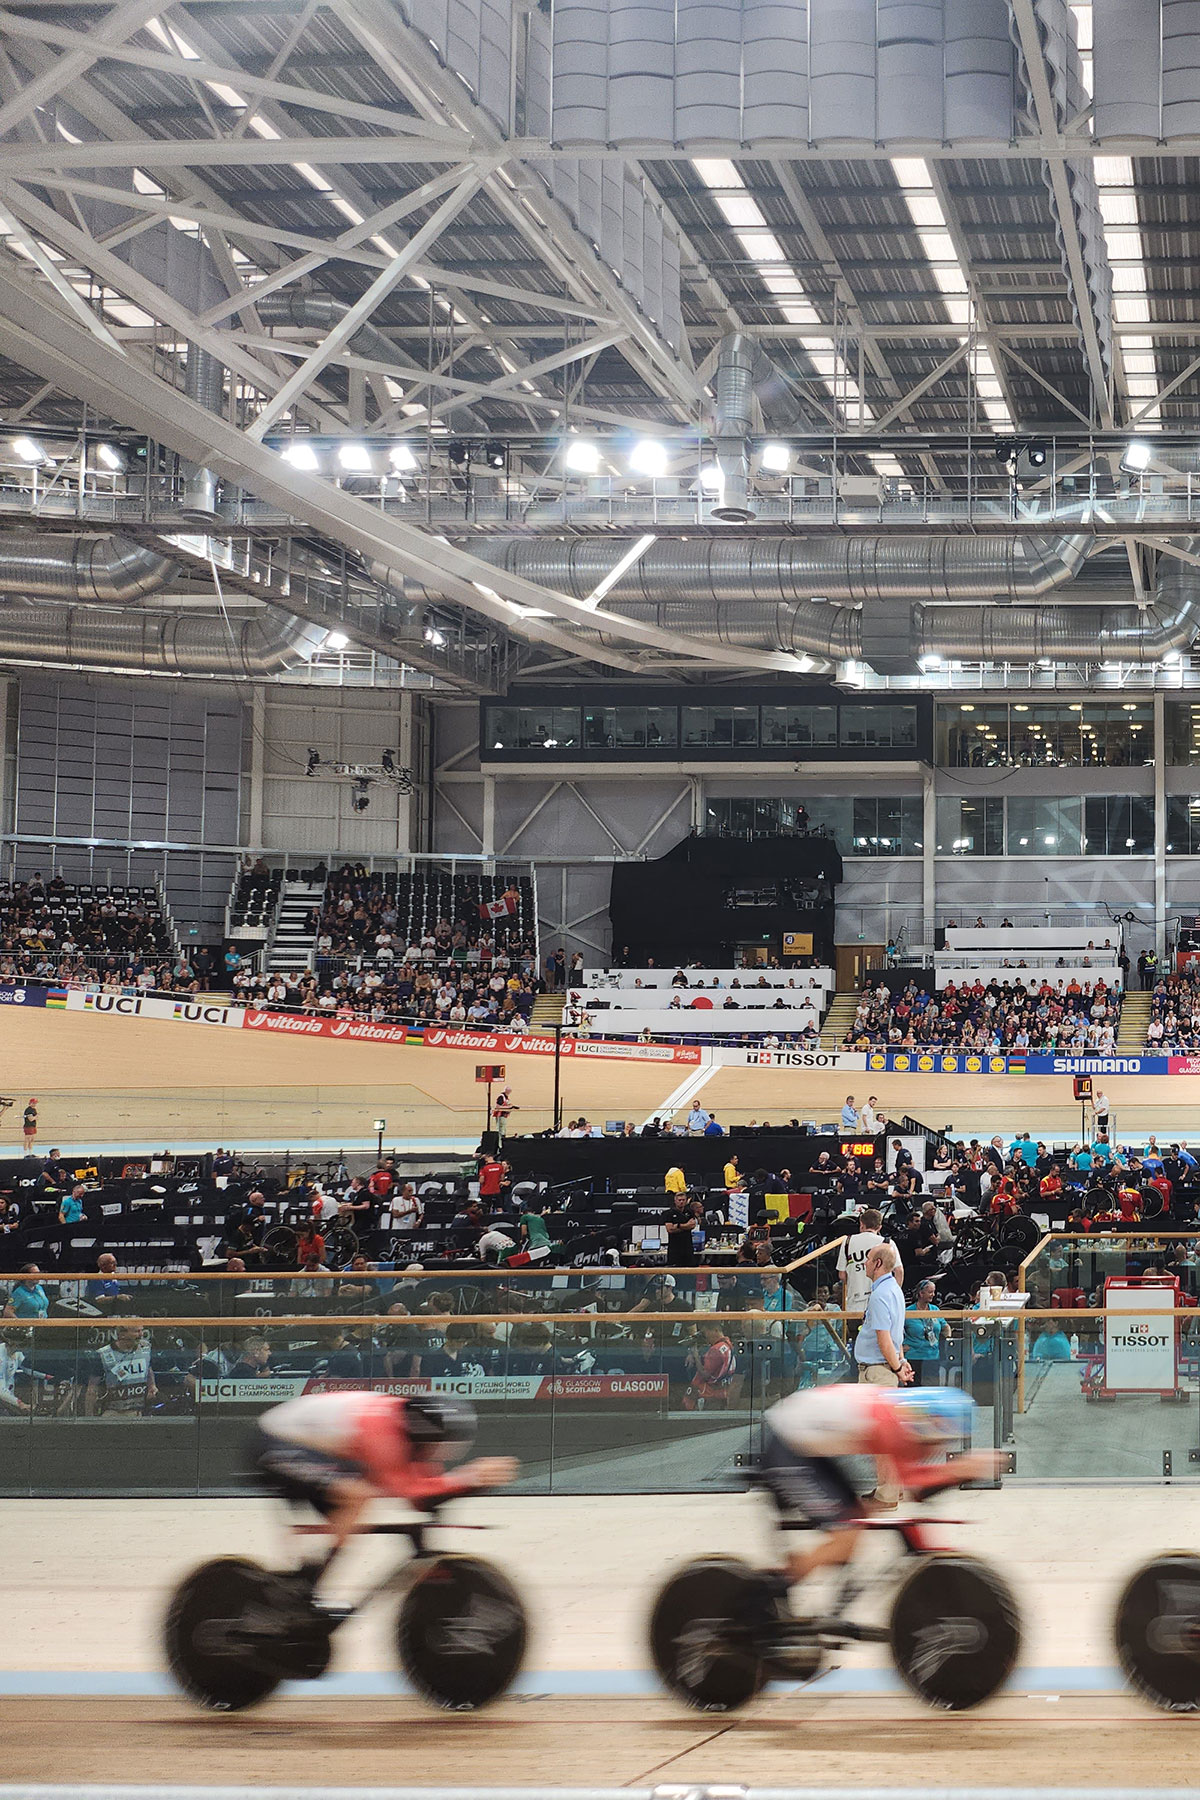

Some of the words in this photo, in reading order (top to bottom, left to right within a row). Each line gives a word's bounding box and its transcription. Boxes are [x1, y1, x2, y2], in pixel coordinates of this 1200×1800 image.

[95, 996, 142, 1014] UCI
[184, 1005, 228, 1024] UCI
[266, 1014, 323, 1033] vittoria
[348, 1022, 403, 1041] vittoria
[446, 1031, 498, 1049] vittoria
[581, 1045, 599, 1053] UCI
[774, 1053, 840, 1067] TISSOT
[1053, 1059, 1141, 1073] SHIMANO
[1083, 1081, 1091, 1093] 10
[411, 1242, 434, 1251] THE
[249, 1279, 273, 1290] THE
[1111, 1335, 1169, 1346] TISSOT
[207, 1385, 237, 1397] UCI
[610, 1380, 664, 1391] GLASGOW
